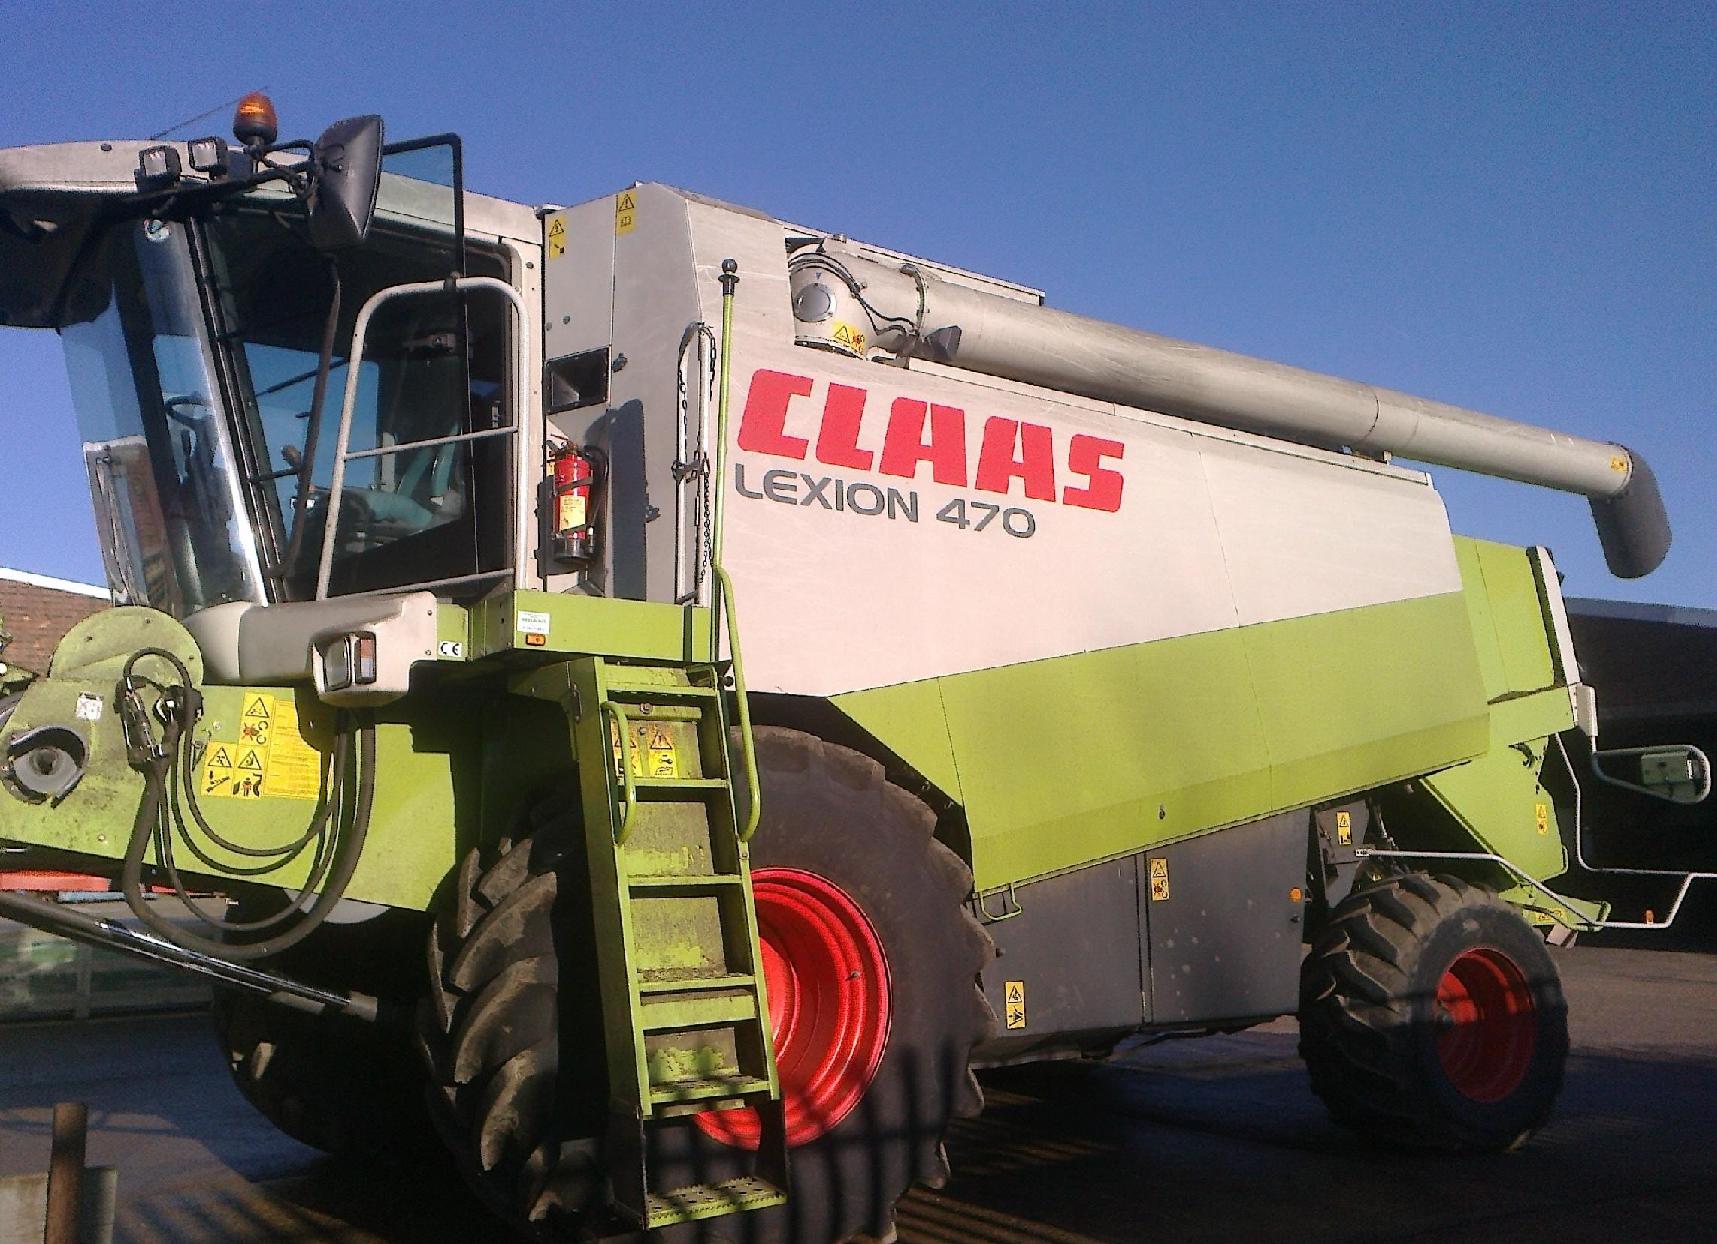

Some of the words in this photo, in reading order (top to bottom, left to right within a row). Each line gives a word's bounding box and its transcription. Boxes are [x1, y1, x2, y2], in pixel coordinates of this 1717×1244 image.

[737, 368, 1125, 513] CLAAS
[735, 463, 919, 523] LEXION
[935, 498, 1037, 539] 470
[440, 642, 460, 656] CE
